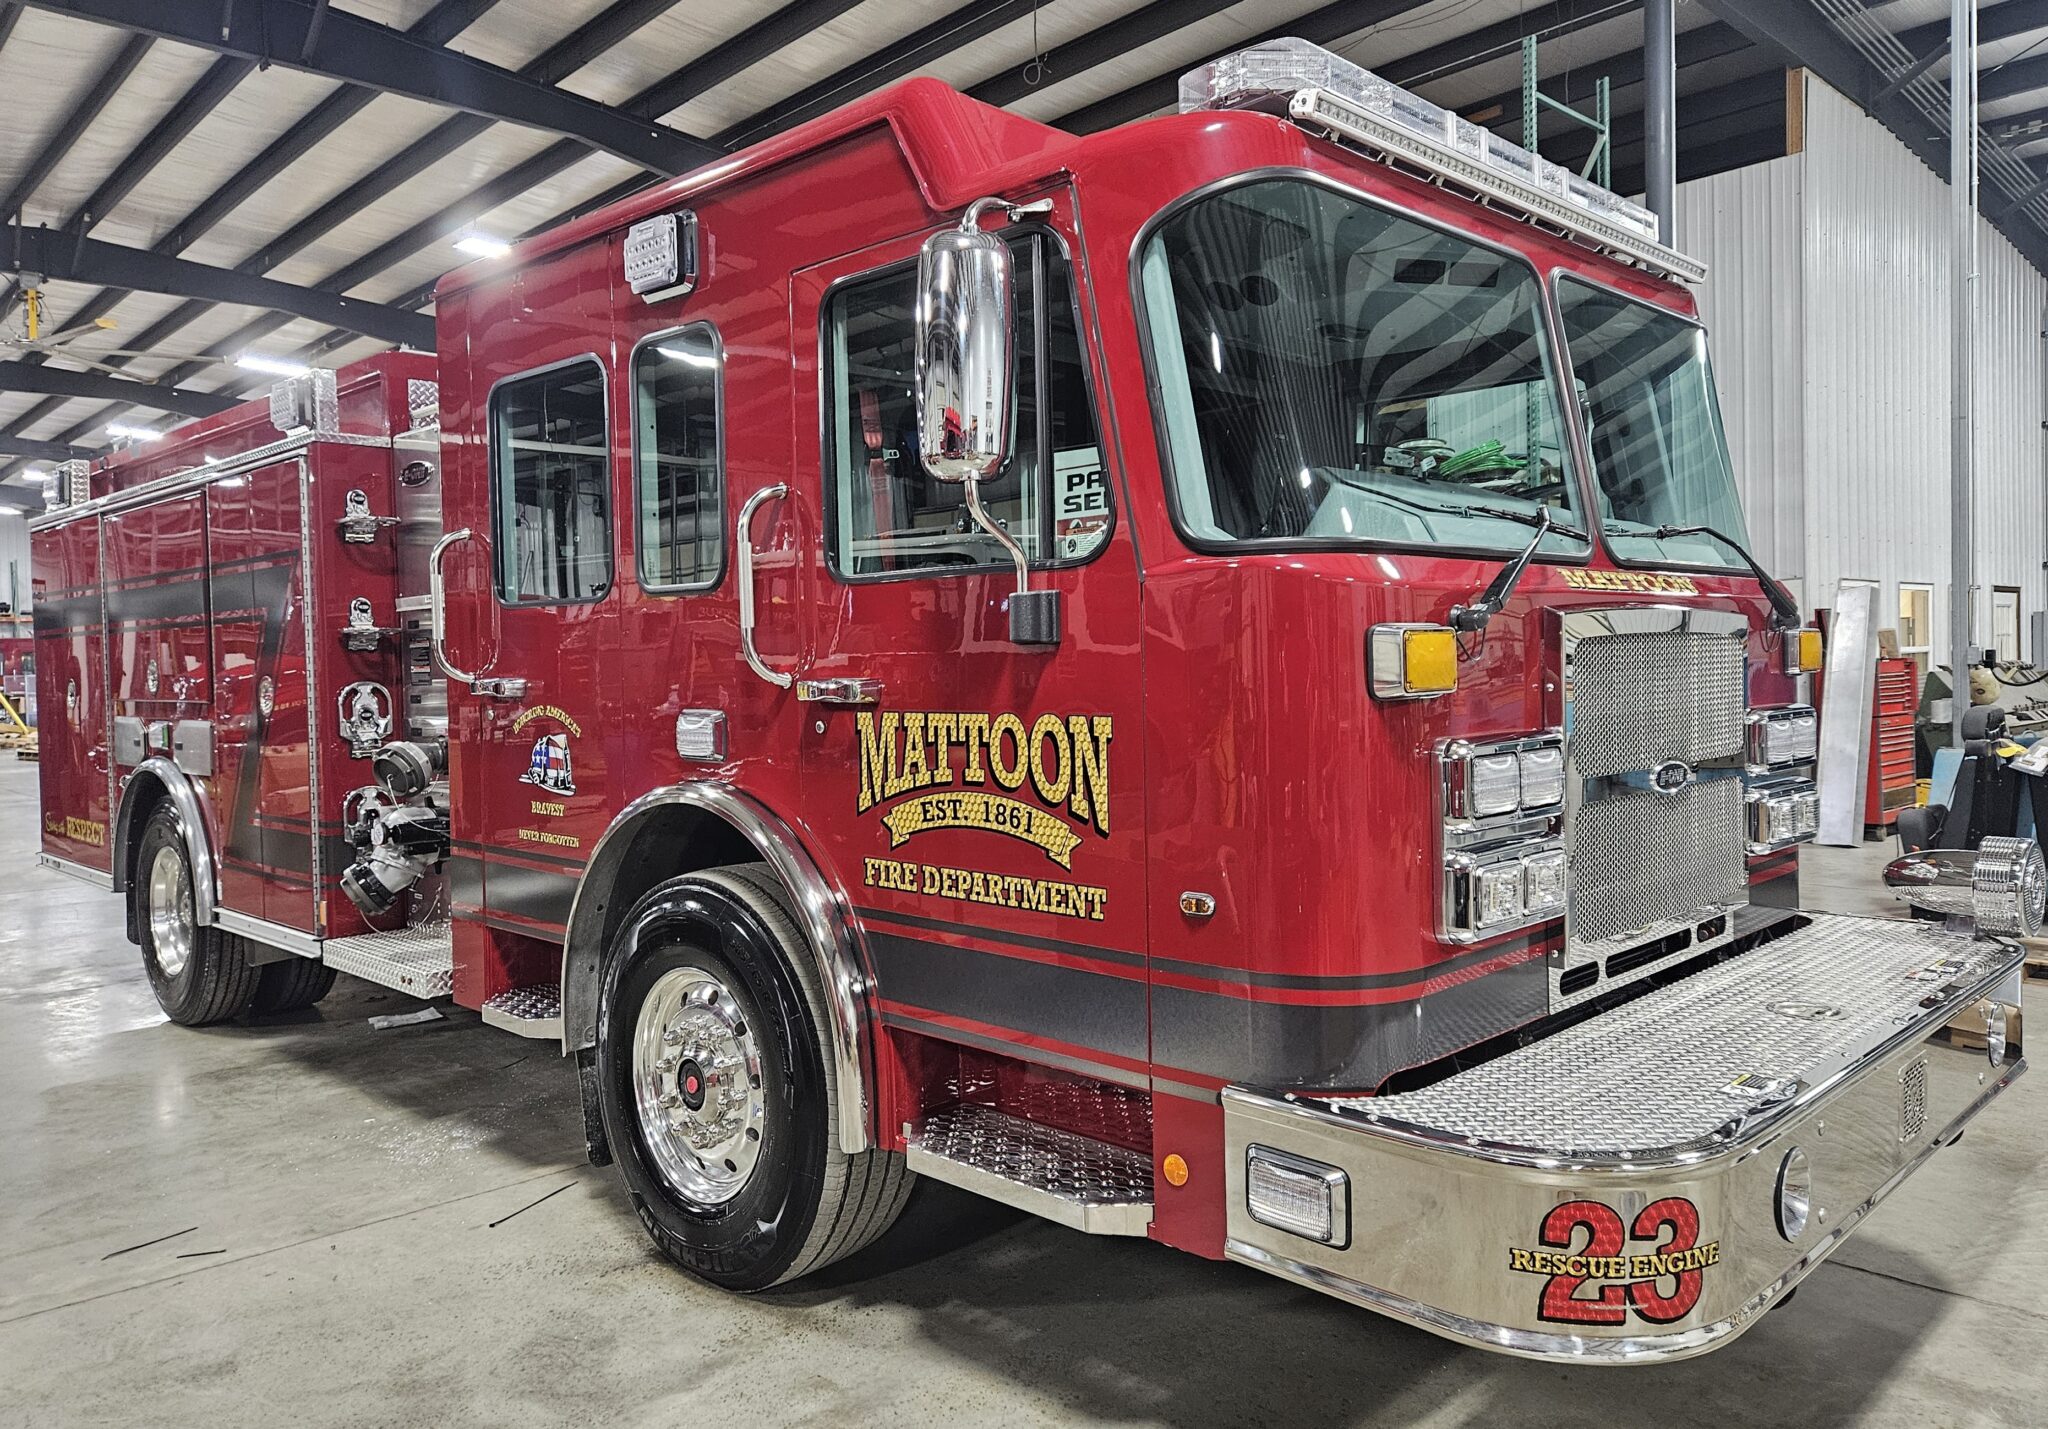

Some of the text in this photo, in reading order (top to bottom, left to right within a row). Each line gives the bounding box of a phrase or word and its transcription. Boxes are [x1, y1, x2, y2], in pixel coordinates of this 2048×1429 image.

[1556, 568, 1699, 594] MATTOON
[856, 711, 1112, 838] MATTOON
[531, 801, 564, 816] BRAVEST
[921, 801, 1033, 833] EST. 1861
[66, 815, 105, 846] RESPECT
[518, 829, 579, 848] NEVER FORGOTTEN
[863, 857, 1107, 920] FIRE DEPARTMENT
[1509, 1240, 1719, 1278] RESCUE ENGINE
[1538, 1197, 1703, 1326] 23
